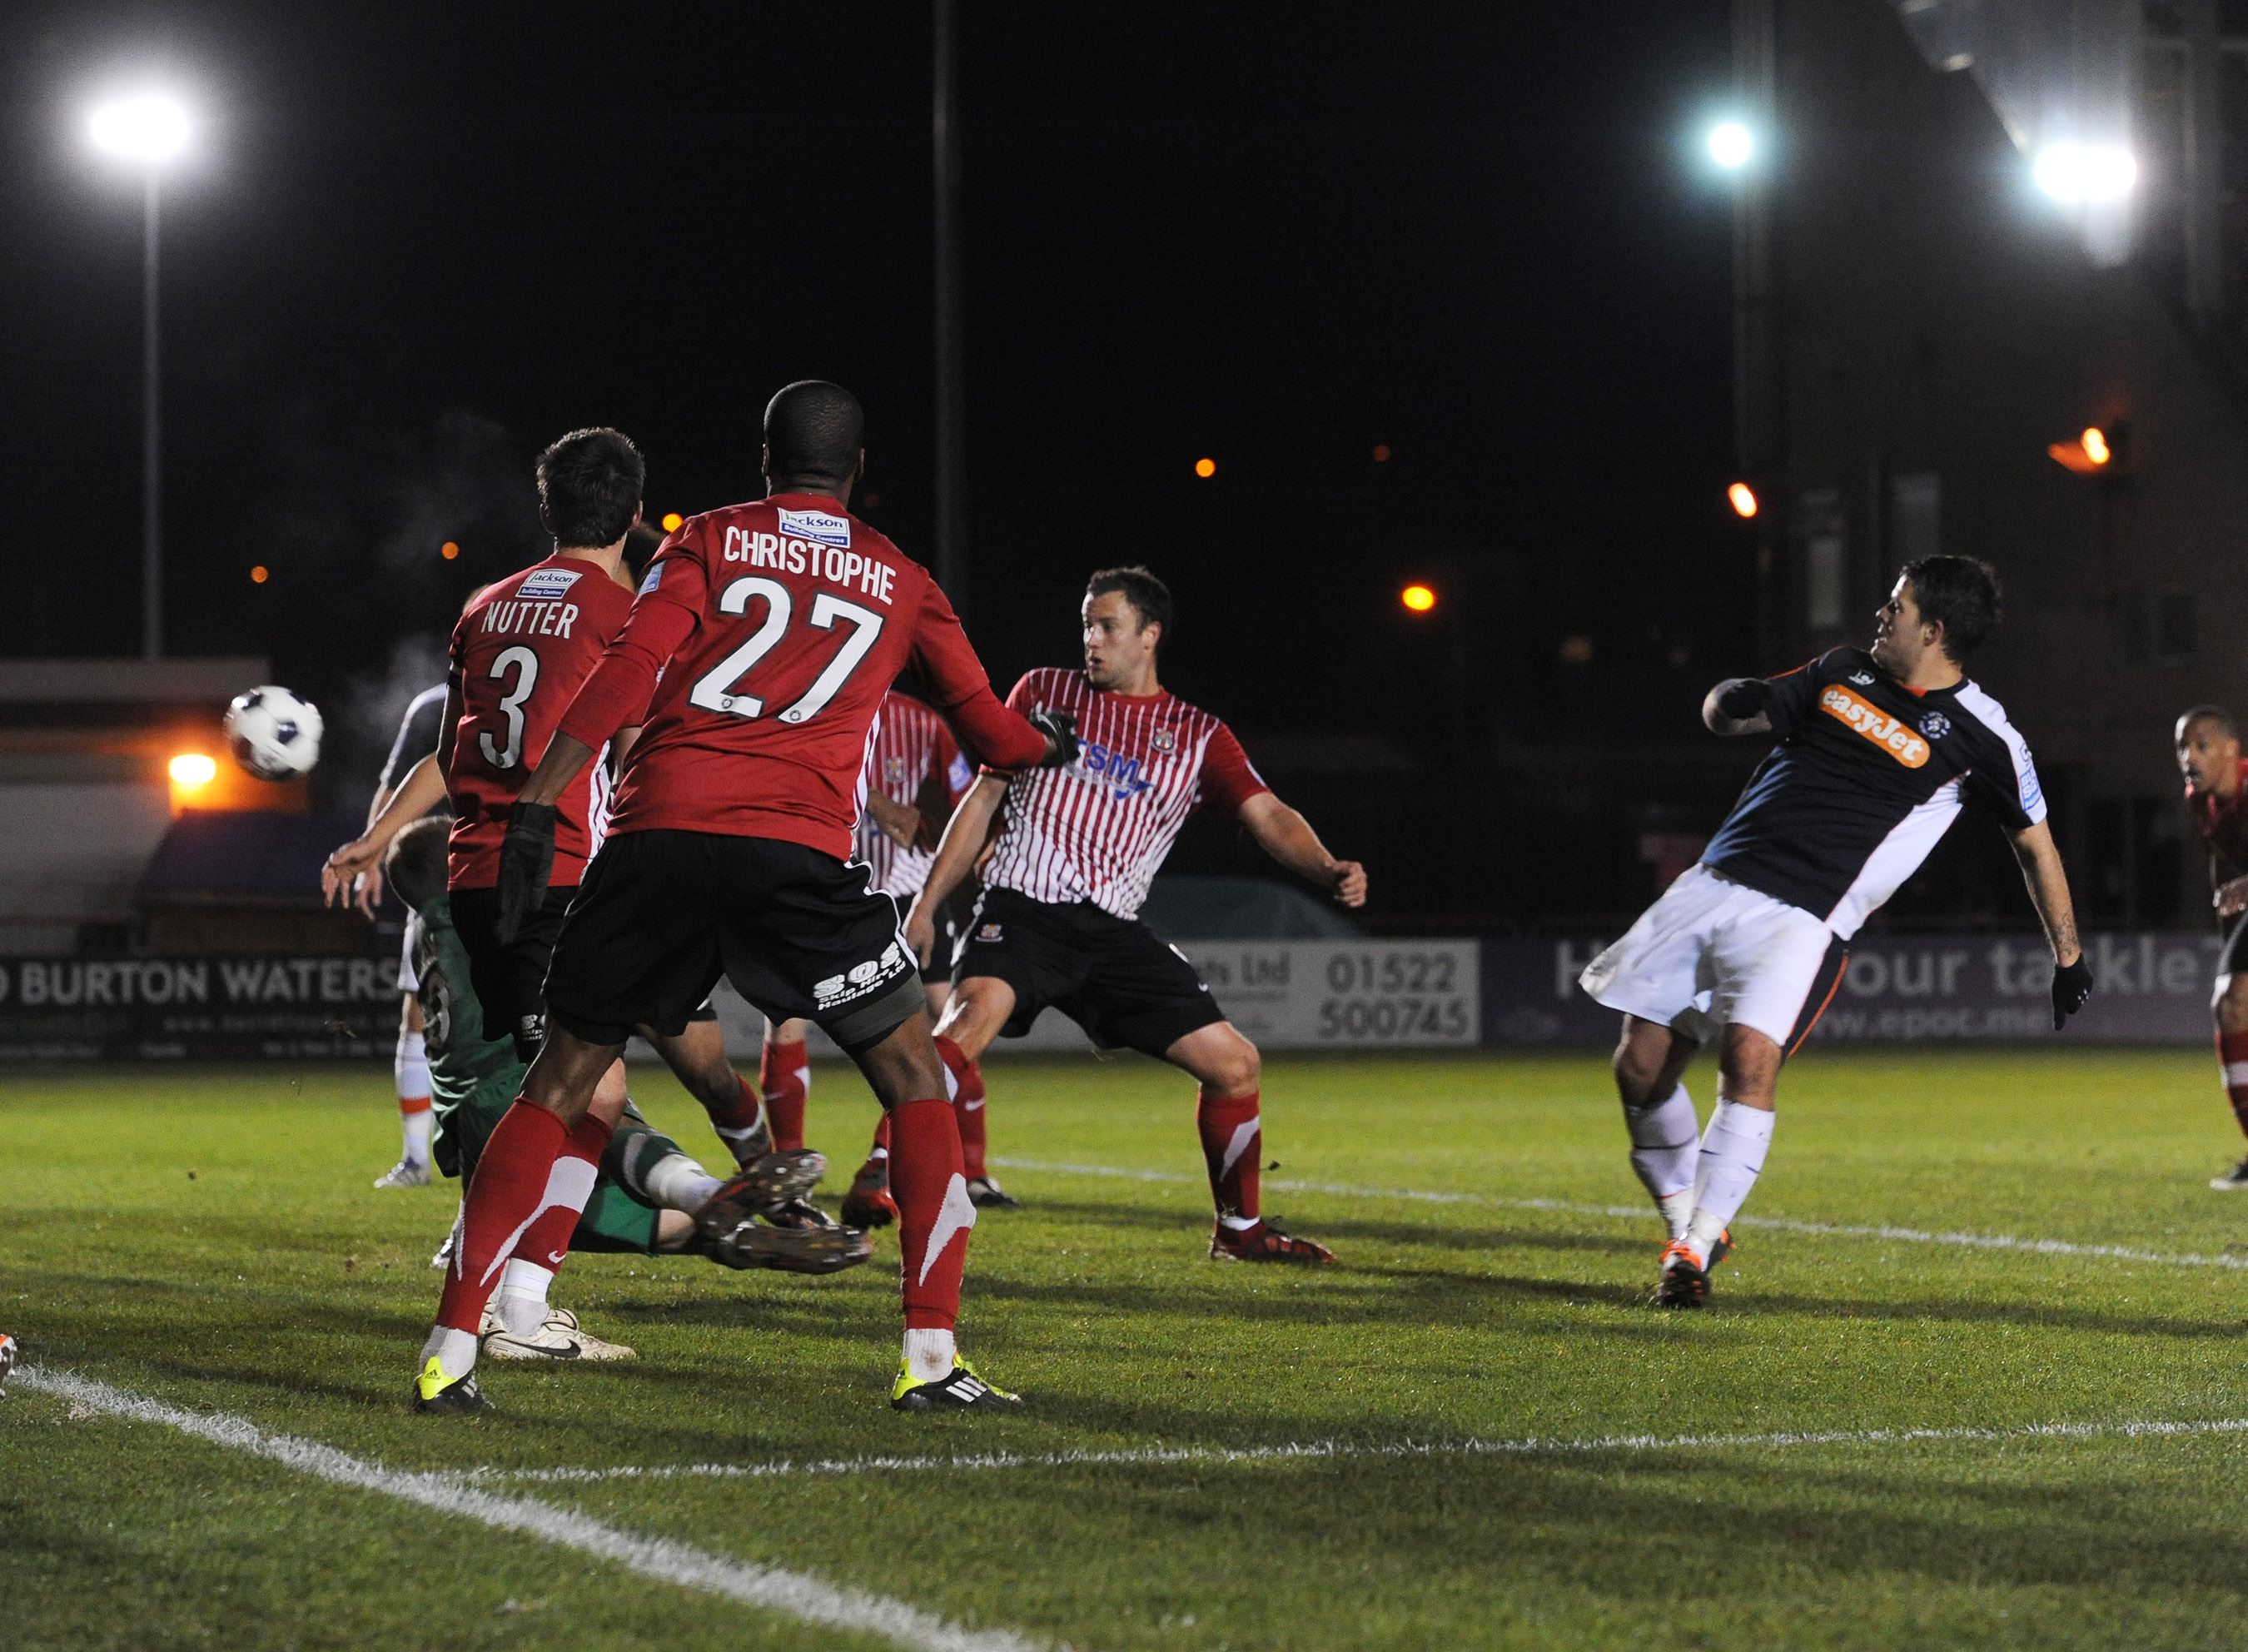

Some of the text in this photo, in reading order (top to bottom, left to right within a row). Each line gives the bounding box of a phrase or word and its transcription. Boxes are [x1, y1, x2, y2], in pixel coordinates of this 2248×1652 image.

[530, 573, 574, 584] Jackson
[724, 525, 897, 605] CHRISTOPHE
[480, 600, 579, 639] NUTTER
[689, 575, 884, 724] 27
[478, 645, 539, 769] 3
[1823, 689, 1923, 761] easyJet
[1077, 739, 1141, 784] SM
[21, 960, 206, 1006] BURTON
[219, 958, 400, 1003] WATERS
[813, 941, 900, 999] SOS
[818, 988, 856, 1003] Skip
[860, 968, 890, 989] Hire
[818, 960, 906, 1011] Haulage Ltd
[1326, 953, 1456, 994] 01522
[1844, 950, 1967, 998] our
[1319, 998, 1469, 1038] 500745
